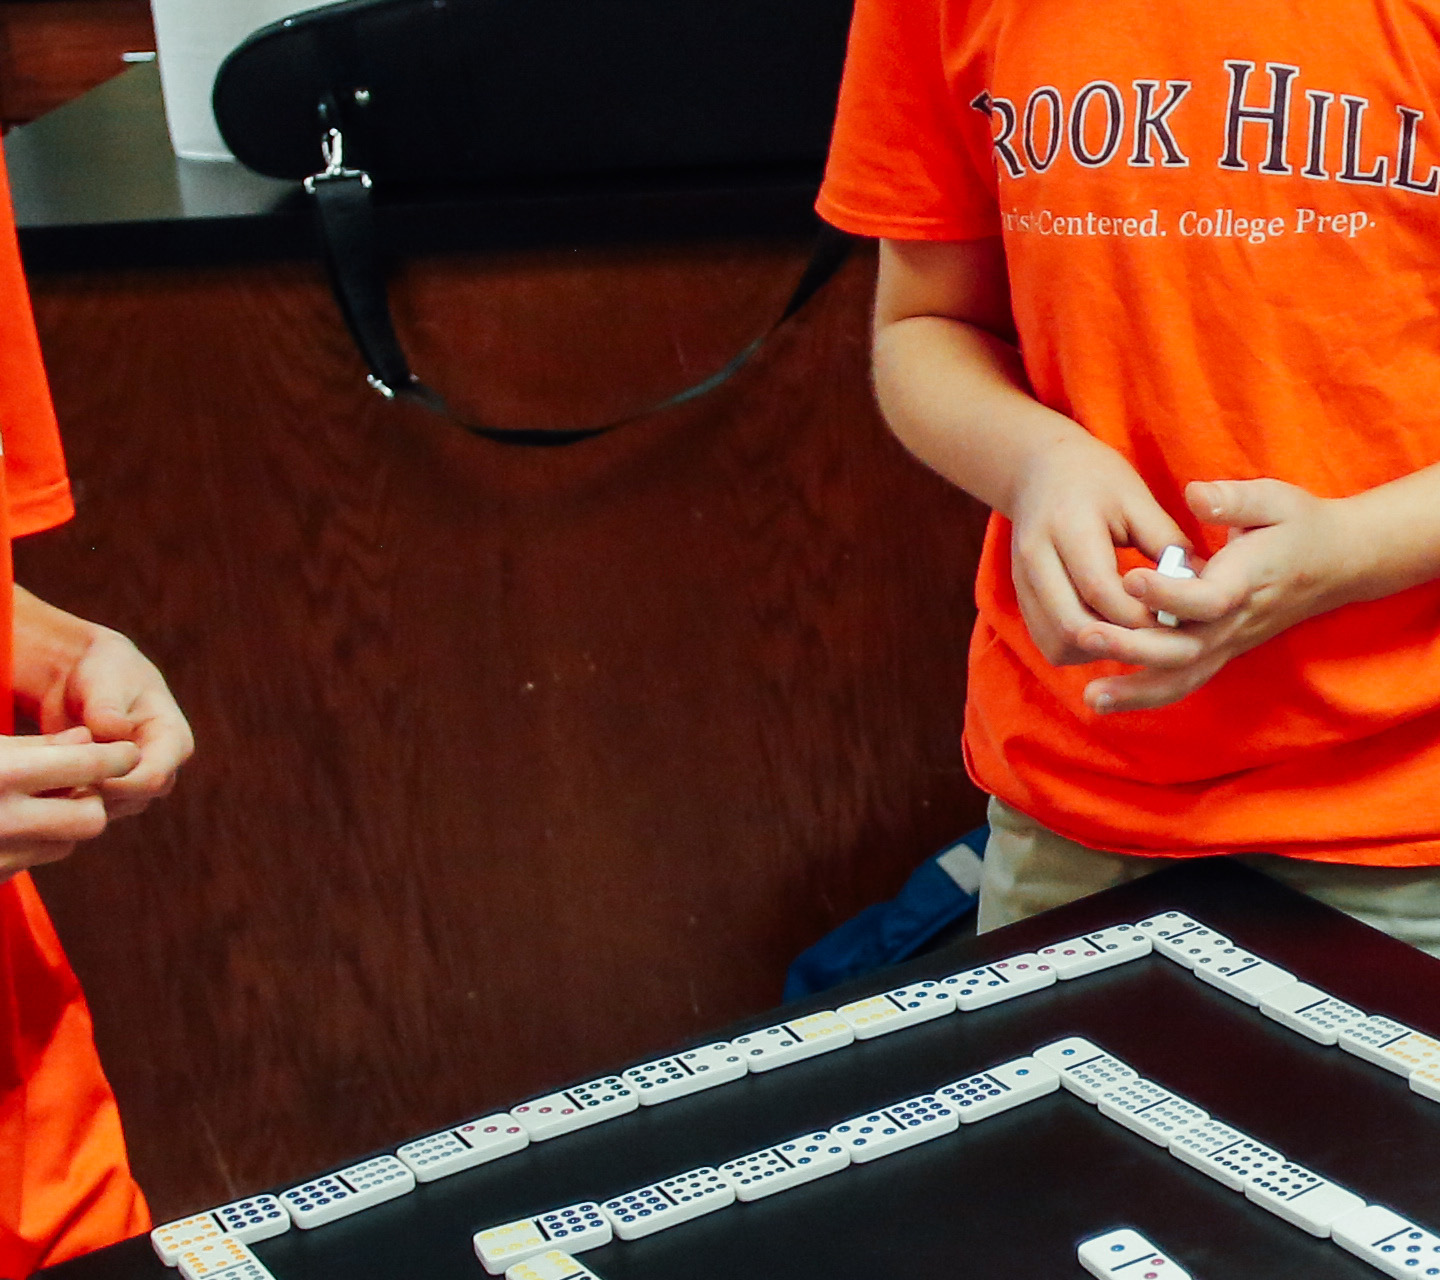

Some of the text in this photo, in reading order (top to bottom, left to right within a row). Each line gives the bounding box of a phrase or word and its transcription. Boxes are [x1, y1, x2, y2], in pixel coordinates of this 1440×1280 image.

[971, 79, 1192, 179] ROOK
[1179, 210, 1285, 244] College
[1295, 206, 1376, 234] Prep.
